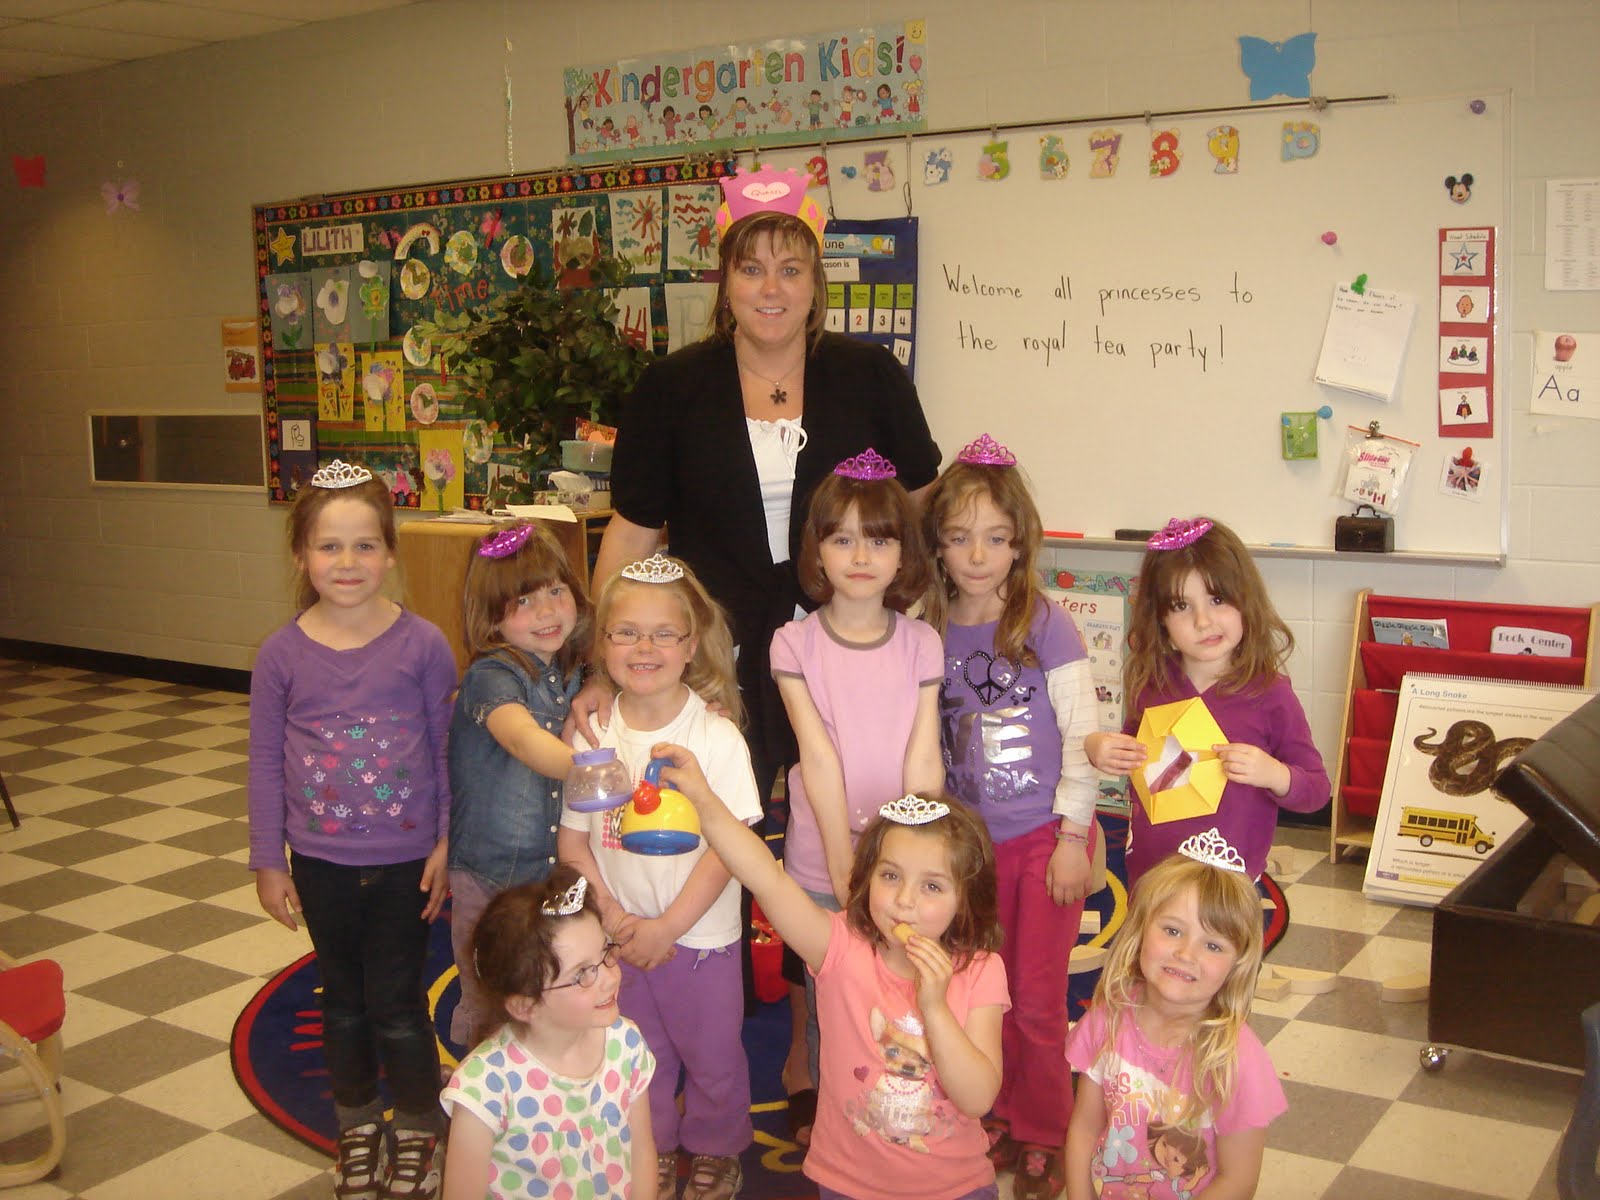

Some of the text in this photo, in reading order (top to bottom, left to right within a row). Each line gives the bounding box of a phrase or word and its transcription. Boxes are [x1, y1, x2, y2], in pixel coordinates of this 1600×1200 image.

[594, 34, 905, 107] Kindergarten Kids!
[824, 240, 845, 249] une
[943, 264, 1253, 317] Welcome all princesses to
[855, 315, 862, 326] 2
[879, 315, 886, 326] 3
[899, 316, 906, 327] 4
[898, 346, 905, 358] 11
[957, 320, 1224, 372] the royal tea party!
[1056, 596, 1098, 614] ters
[1498, 632, 1566, 650] Book Center
[1420, 689, 1440, 698] Long
[1443, 690, 1467, 699] Snake
